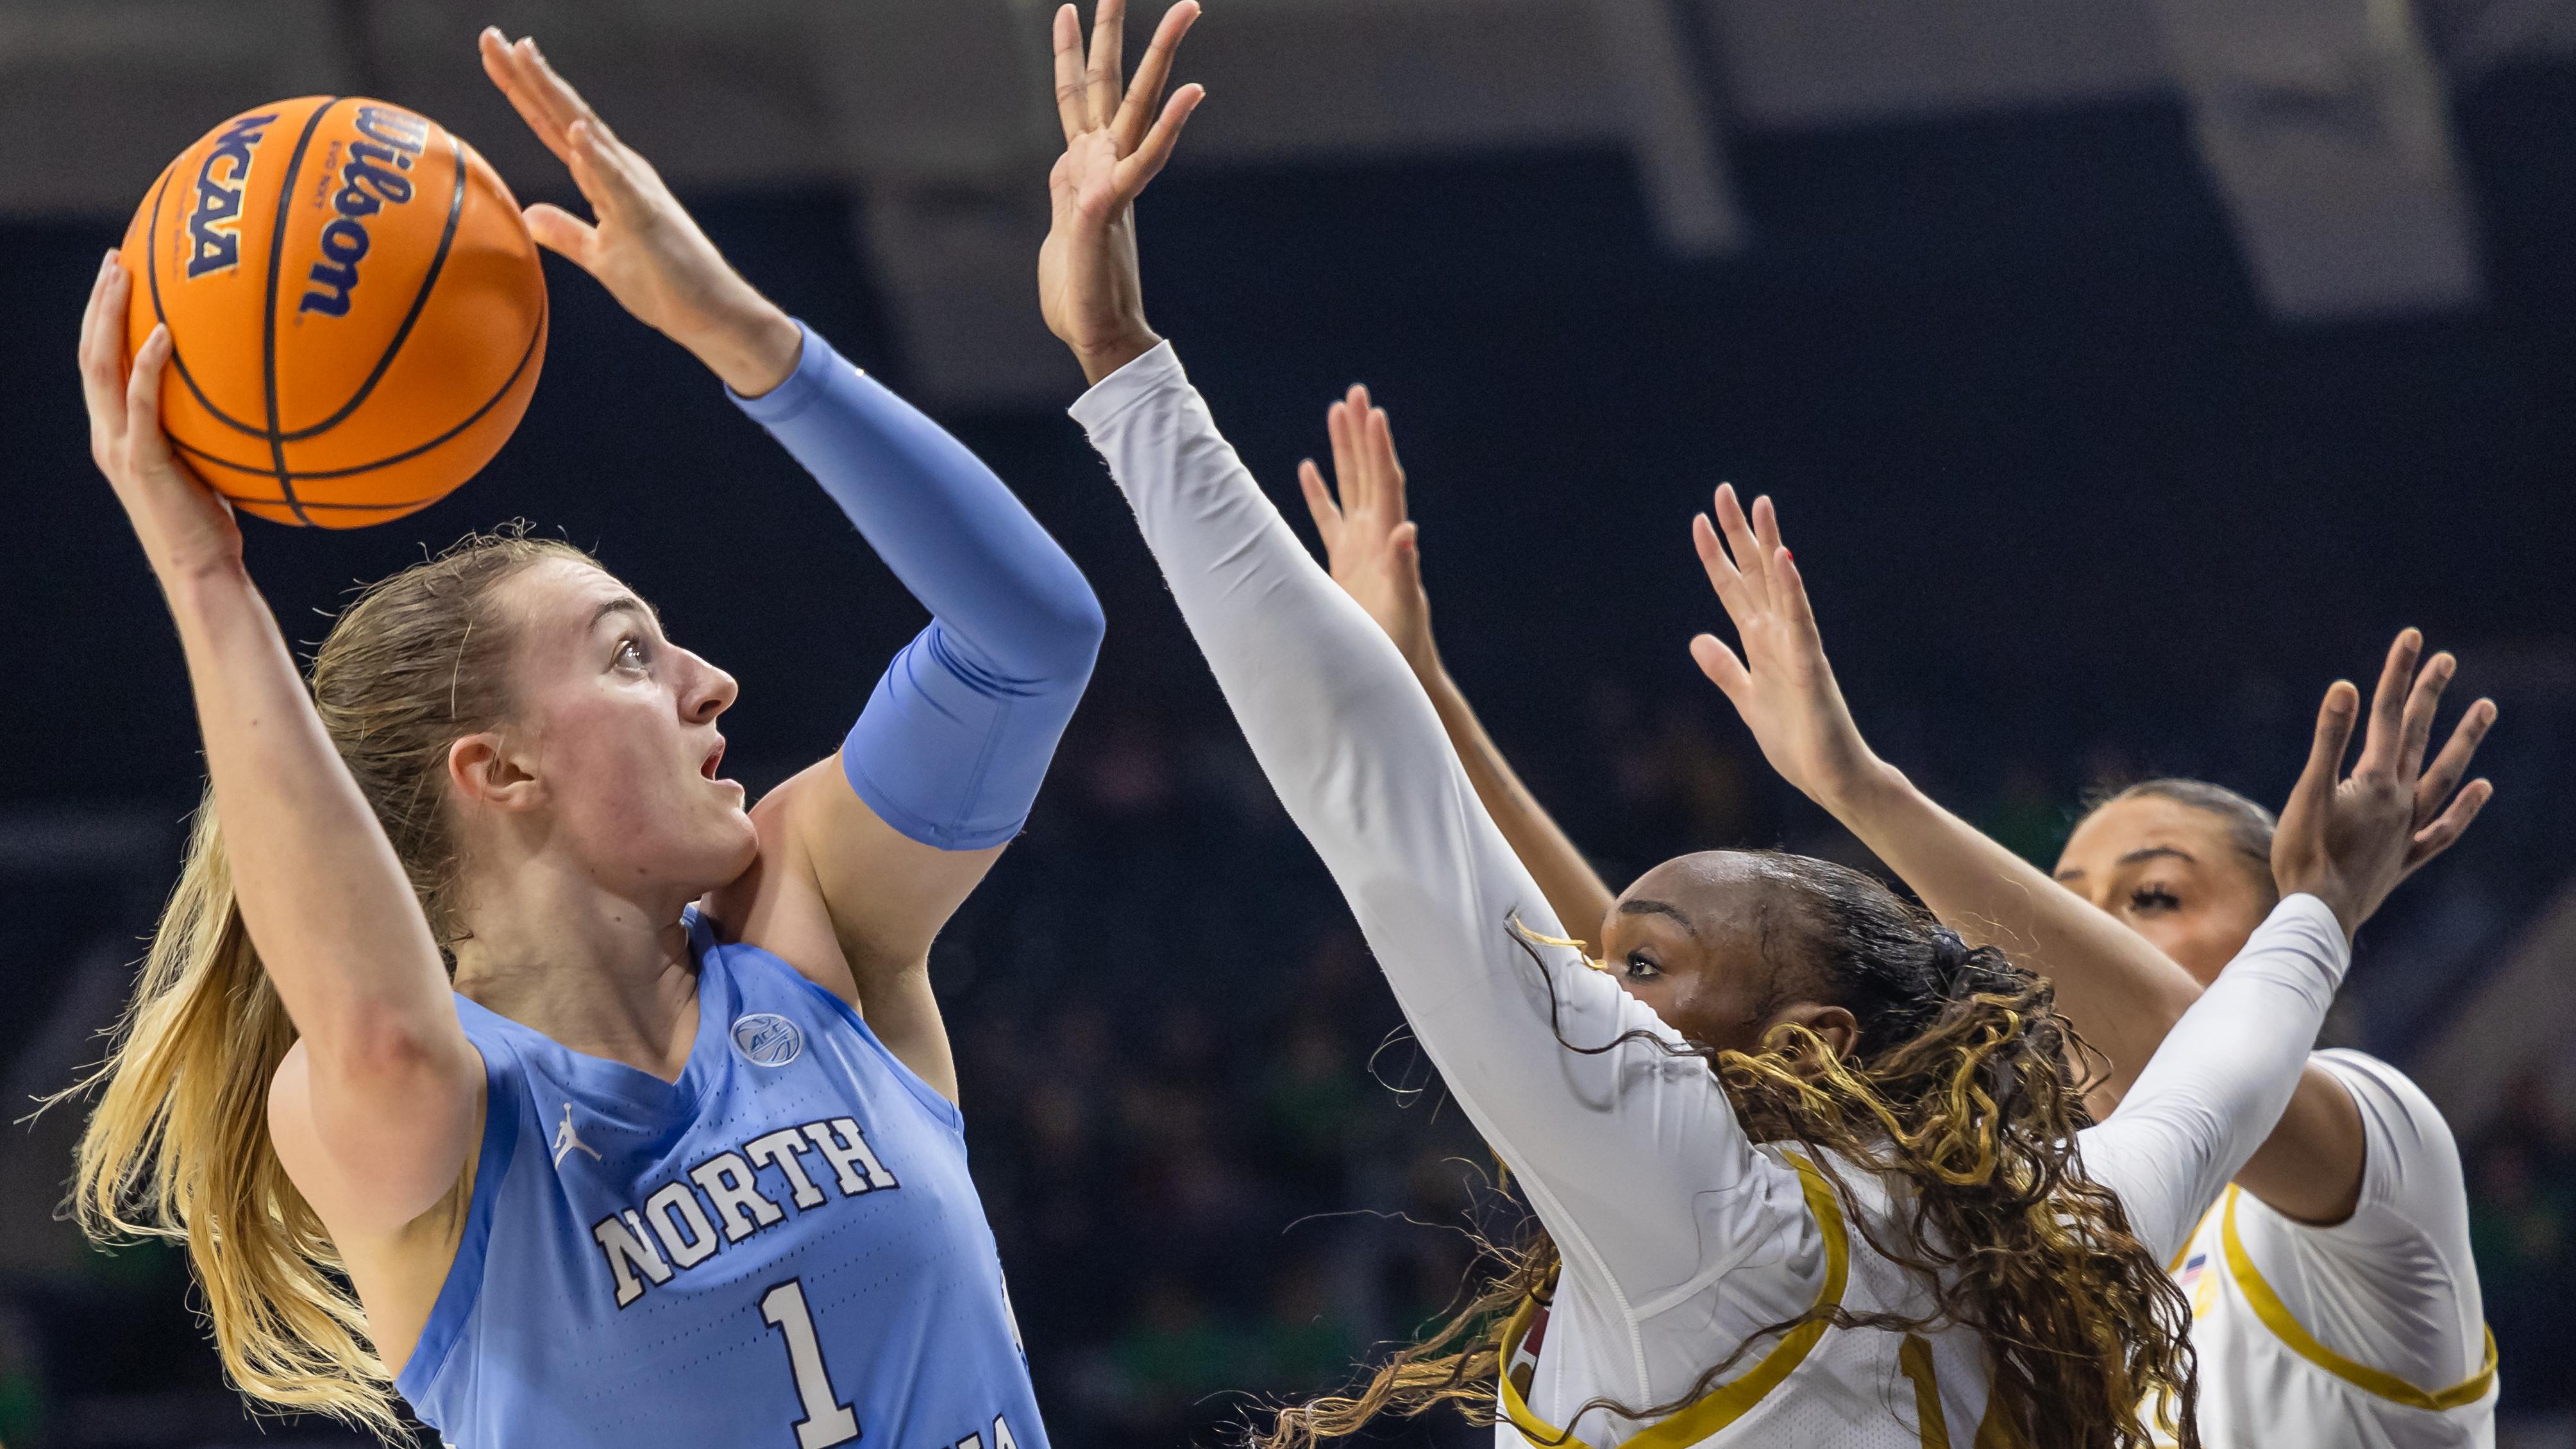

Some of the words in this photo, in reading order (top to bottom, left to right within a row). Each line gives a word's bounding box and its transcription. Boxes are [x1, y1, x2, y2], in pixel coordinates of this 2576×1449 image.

[187, 114, 279, 282] NCAA
[299, 106, 430, 318] Wilson
[592, 1116, 900, 1310] NORTH
[758, 1276, 862, 1449] 1
